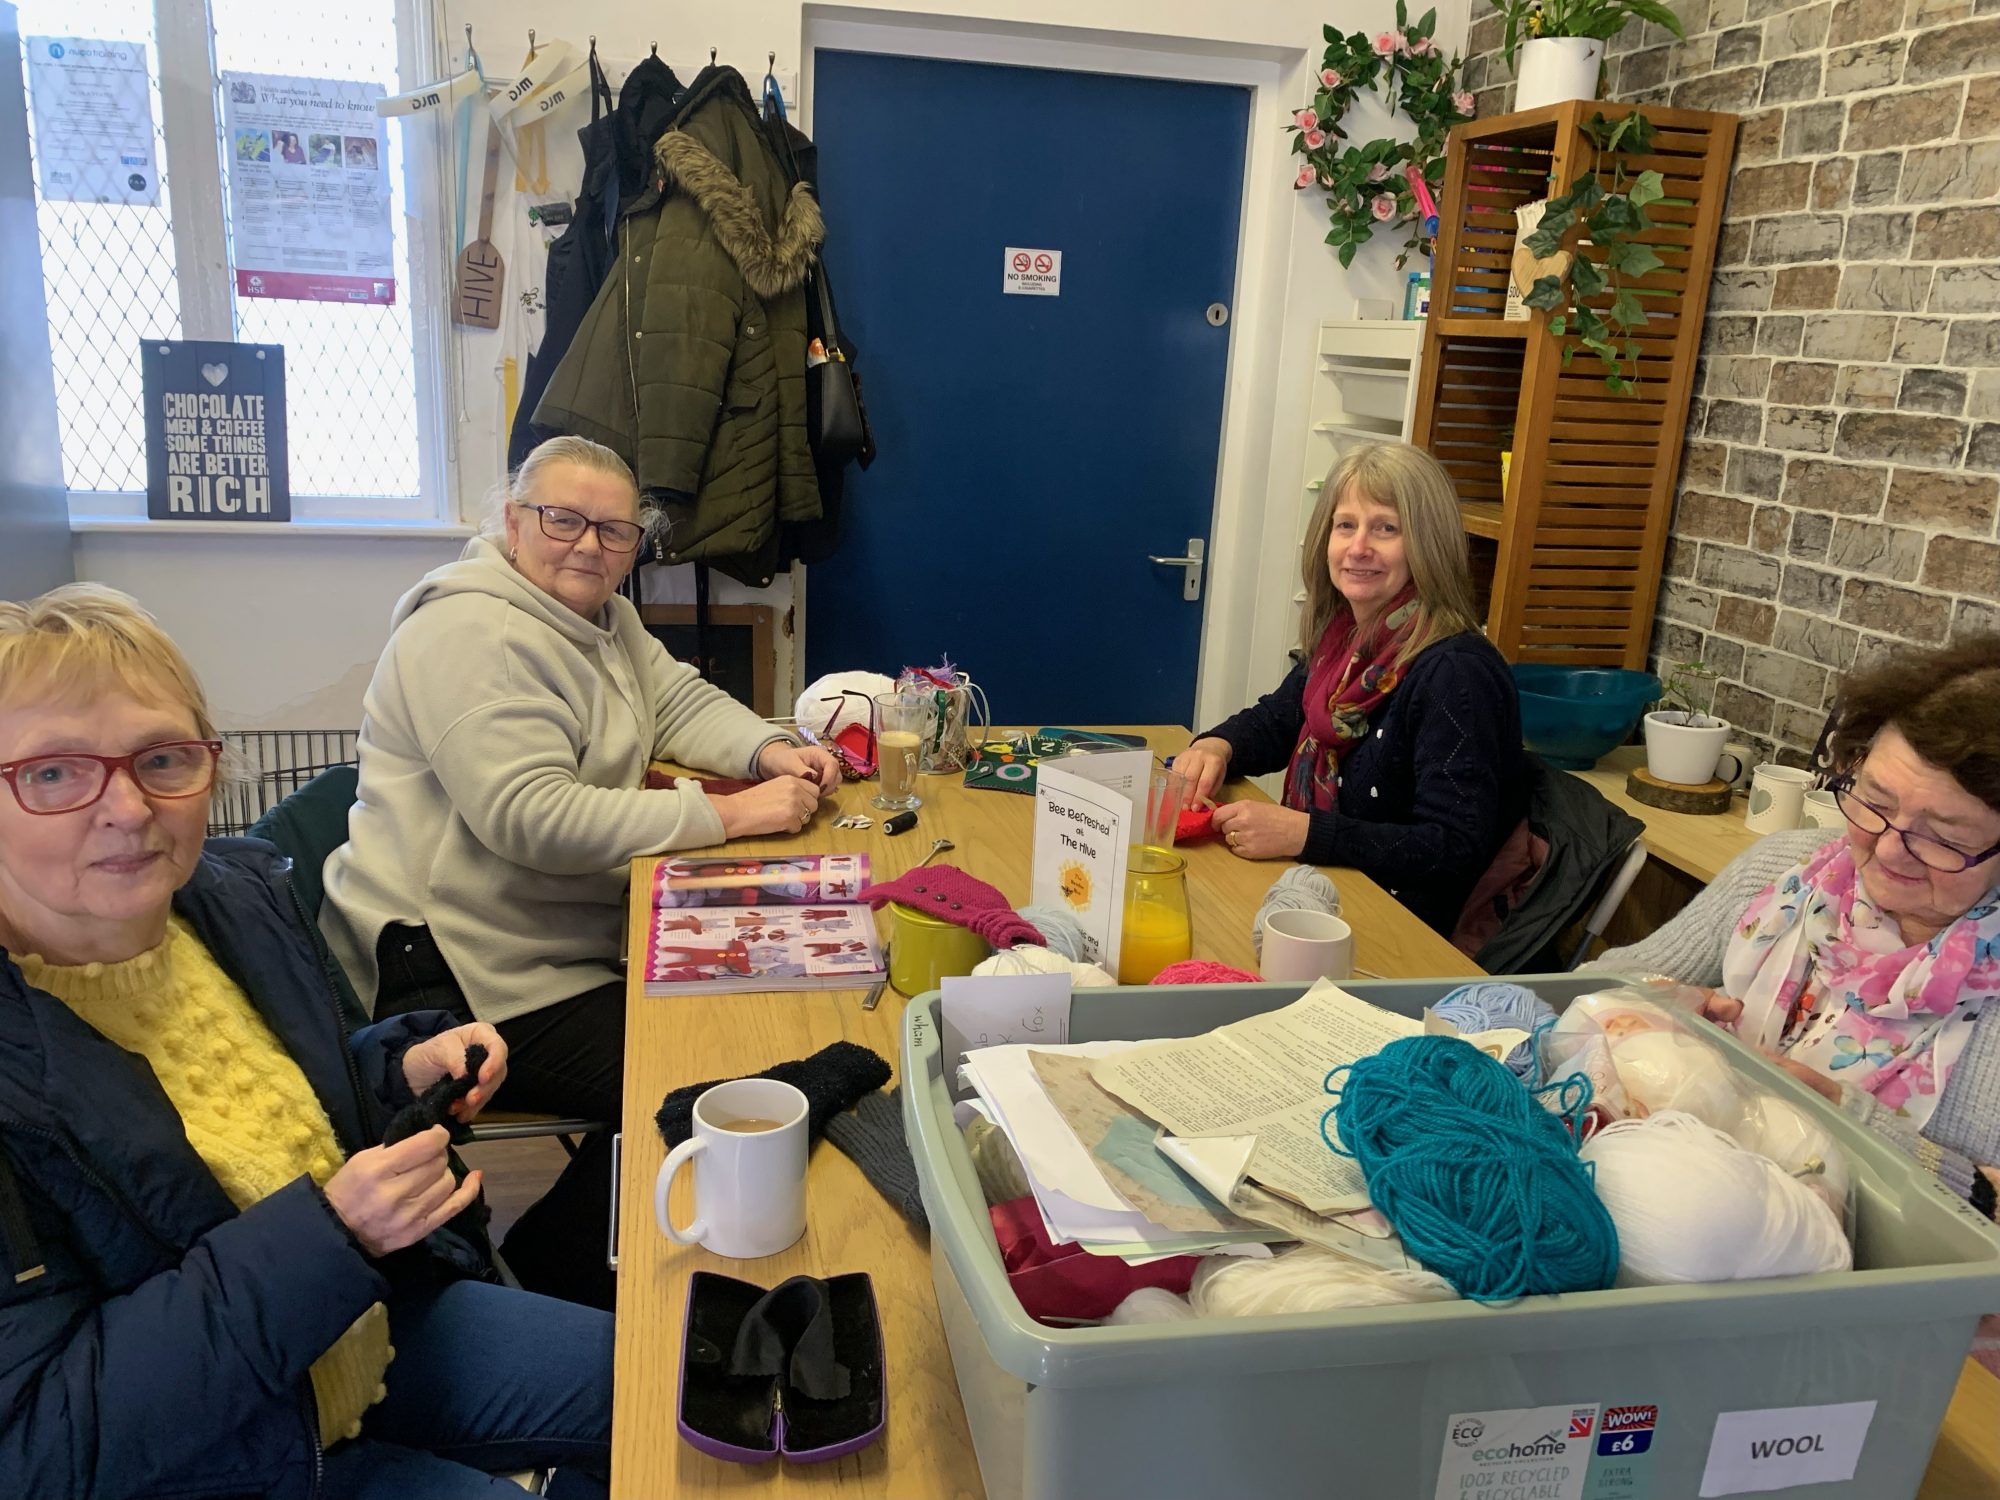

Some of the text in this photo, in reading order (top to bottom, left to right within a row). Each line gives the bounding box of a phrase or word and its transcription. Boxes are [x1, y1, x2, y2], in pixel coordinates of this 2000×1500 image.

[261, 93, 375, 112] What you need to know
[463, 251, 497, 320] HIVE
[1007, 273, 1057, 282] NO SMOKING
[247, 286, 265, 294] HSE
[163, 392, 264, 420] CHOCOLATE
[165, 418, 265, 436] MEN & COFFEE
[166, 435, 265, 454] SOME THINGS
[168, 453, 269, 476] ARE BETTER
[168, 475, 271, 513] RICH
[1048, 801, 1110, 836] Bee Refreshed
[1075, 828, 1085, 837] at
[1060, 833, 1096, 859] The Hive
[911, 1015, 929, 1047] wham
[1608, 1411, 1652, 1429] WOW!
[1452, 1427, 1483, 1440] ECO
[1611, 1434, 1634, 1452] £6
[1472, 1442, 1566, 1462] ecohome
[1751, 1434, 1825, 1459] WOOL
[1460, 1466, 1570, 1489] 100% RECYCLED
[1476, 1483, 1563, 1500] RECYCLABLE
